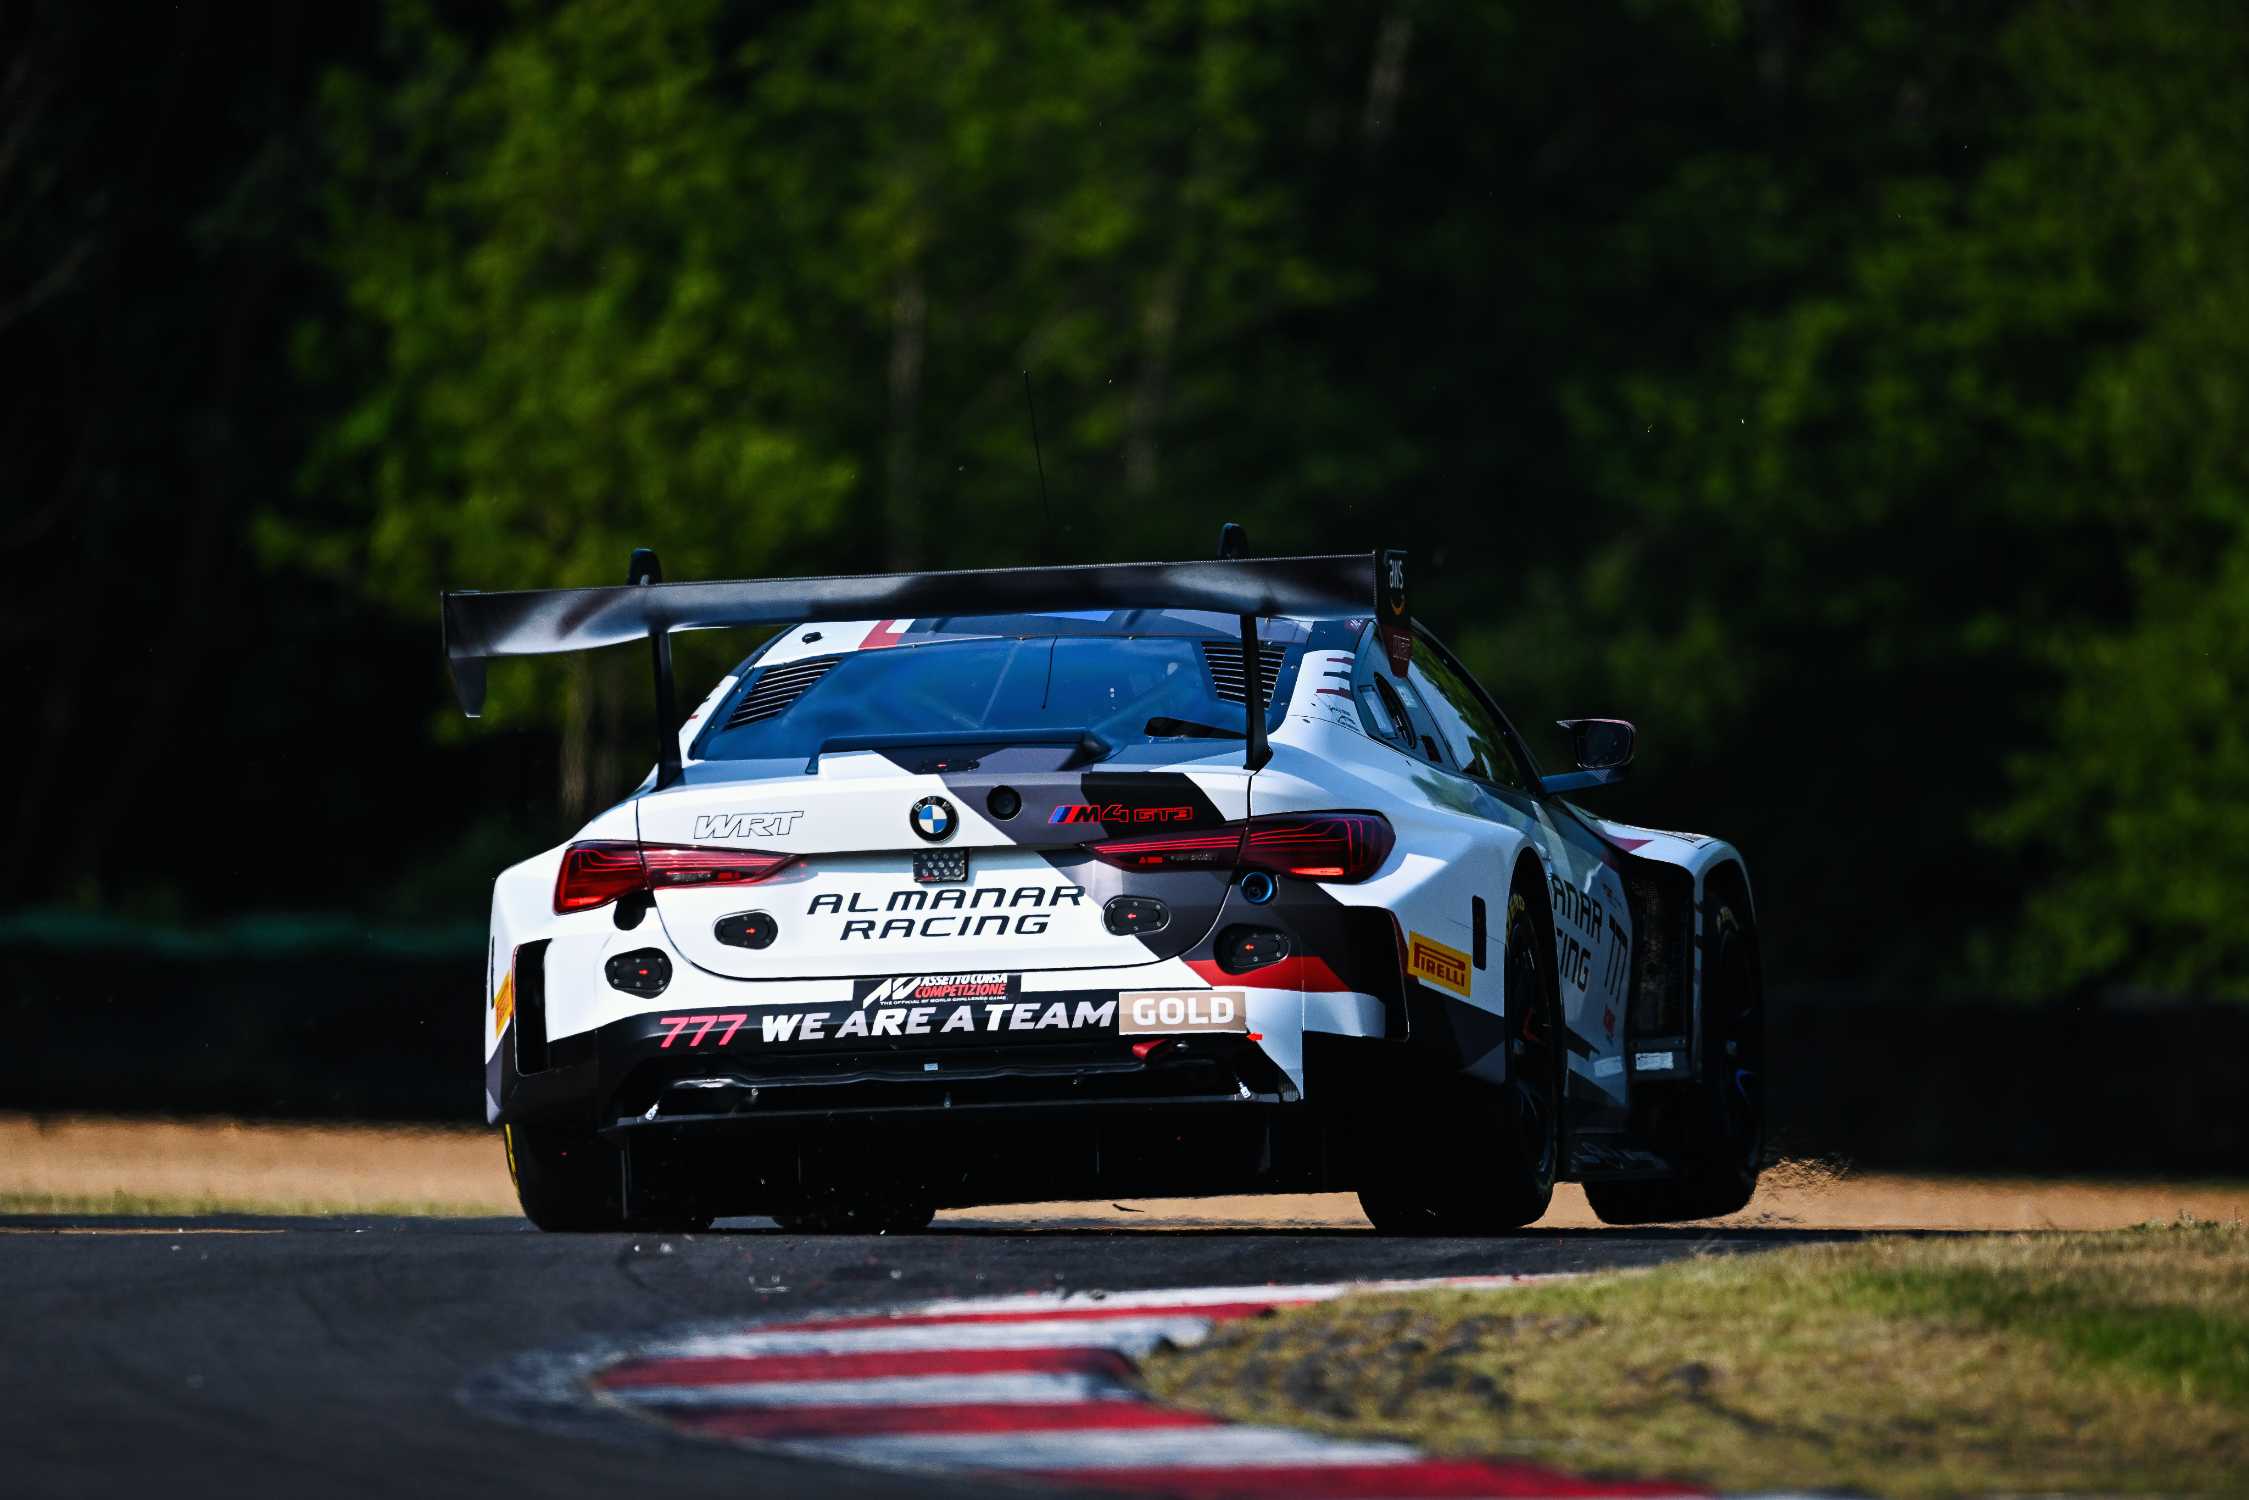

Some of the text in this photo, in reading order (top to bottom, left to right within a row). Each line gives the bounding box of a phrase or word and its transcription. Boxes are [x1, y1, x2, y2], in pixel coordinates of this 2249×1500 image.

[694, 811, 804, 839] WRT
[1134, 806, 1193, 822] GT3
[807, 886, 1086, 914] ALMANAR
[1550, 873, 1603, 944] ANAR
[840, 914, 1051, 940] RACING
[1413, 941, 1466, 988] PIRELLI
[915, 983, 1007, 998] COMPETIZIONE
[762, 1001, 1117, 1042] WE ARE A TEAM
[1132, 997, 1235, 1026] GOLD
[660, 1014, 748, 1048] 777
